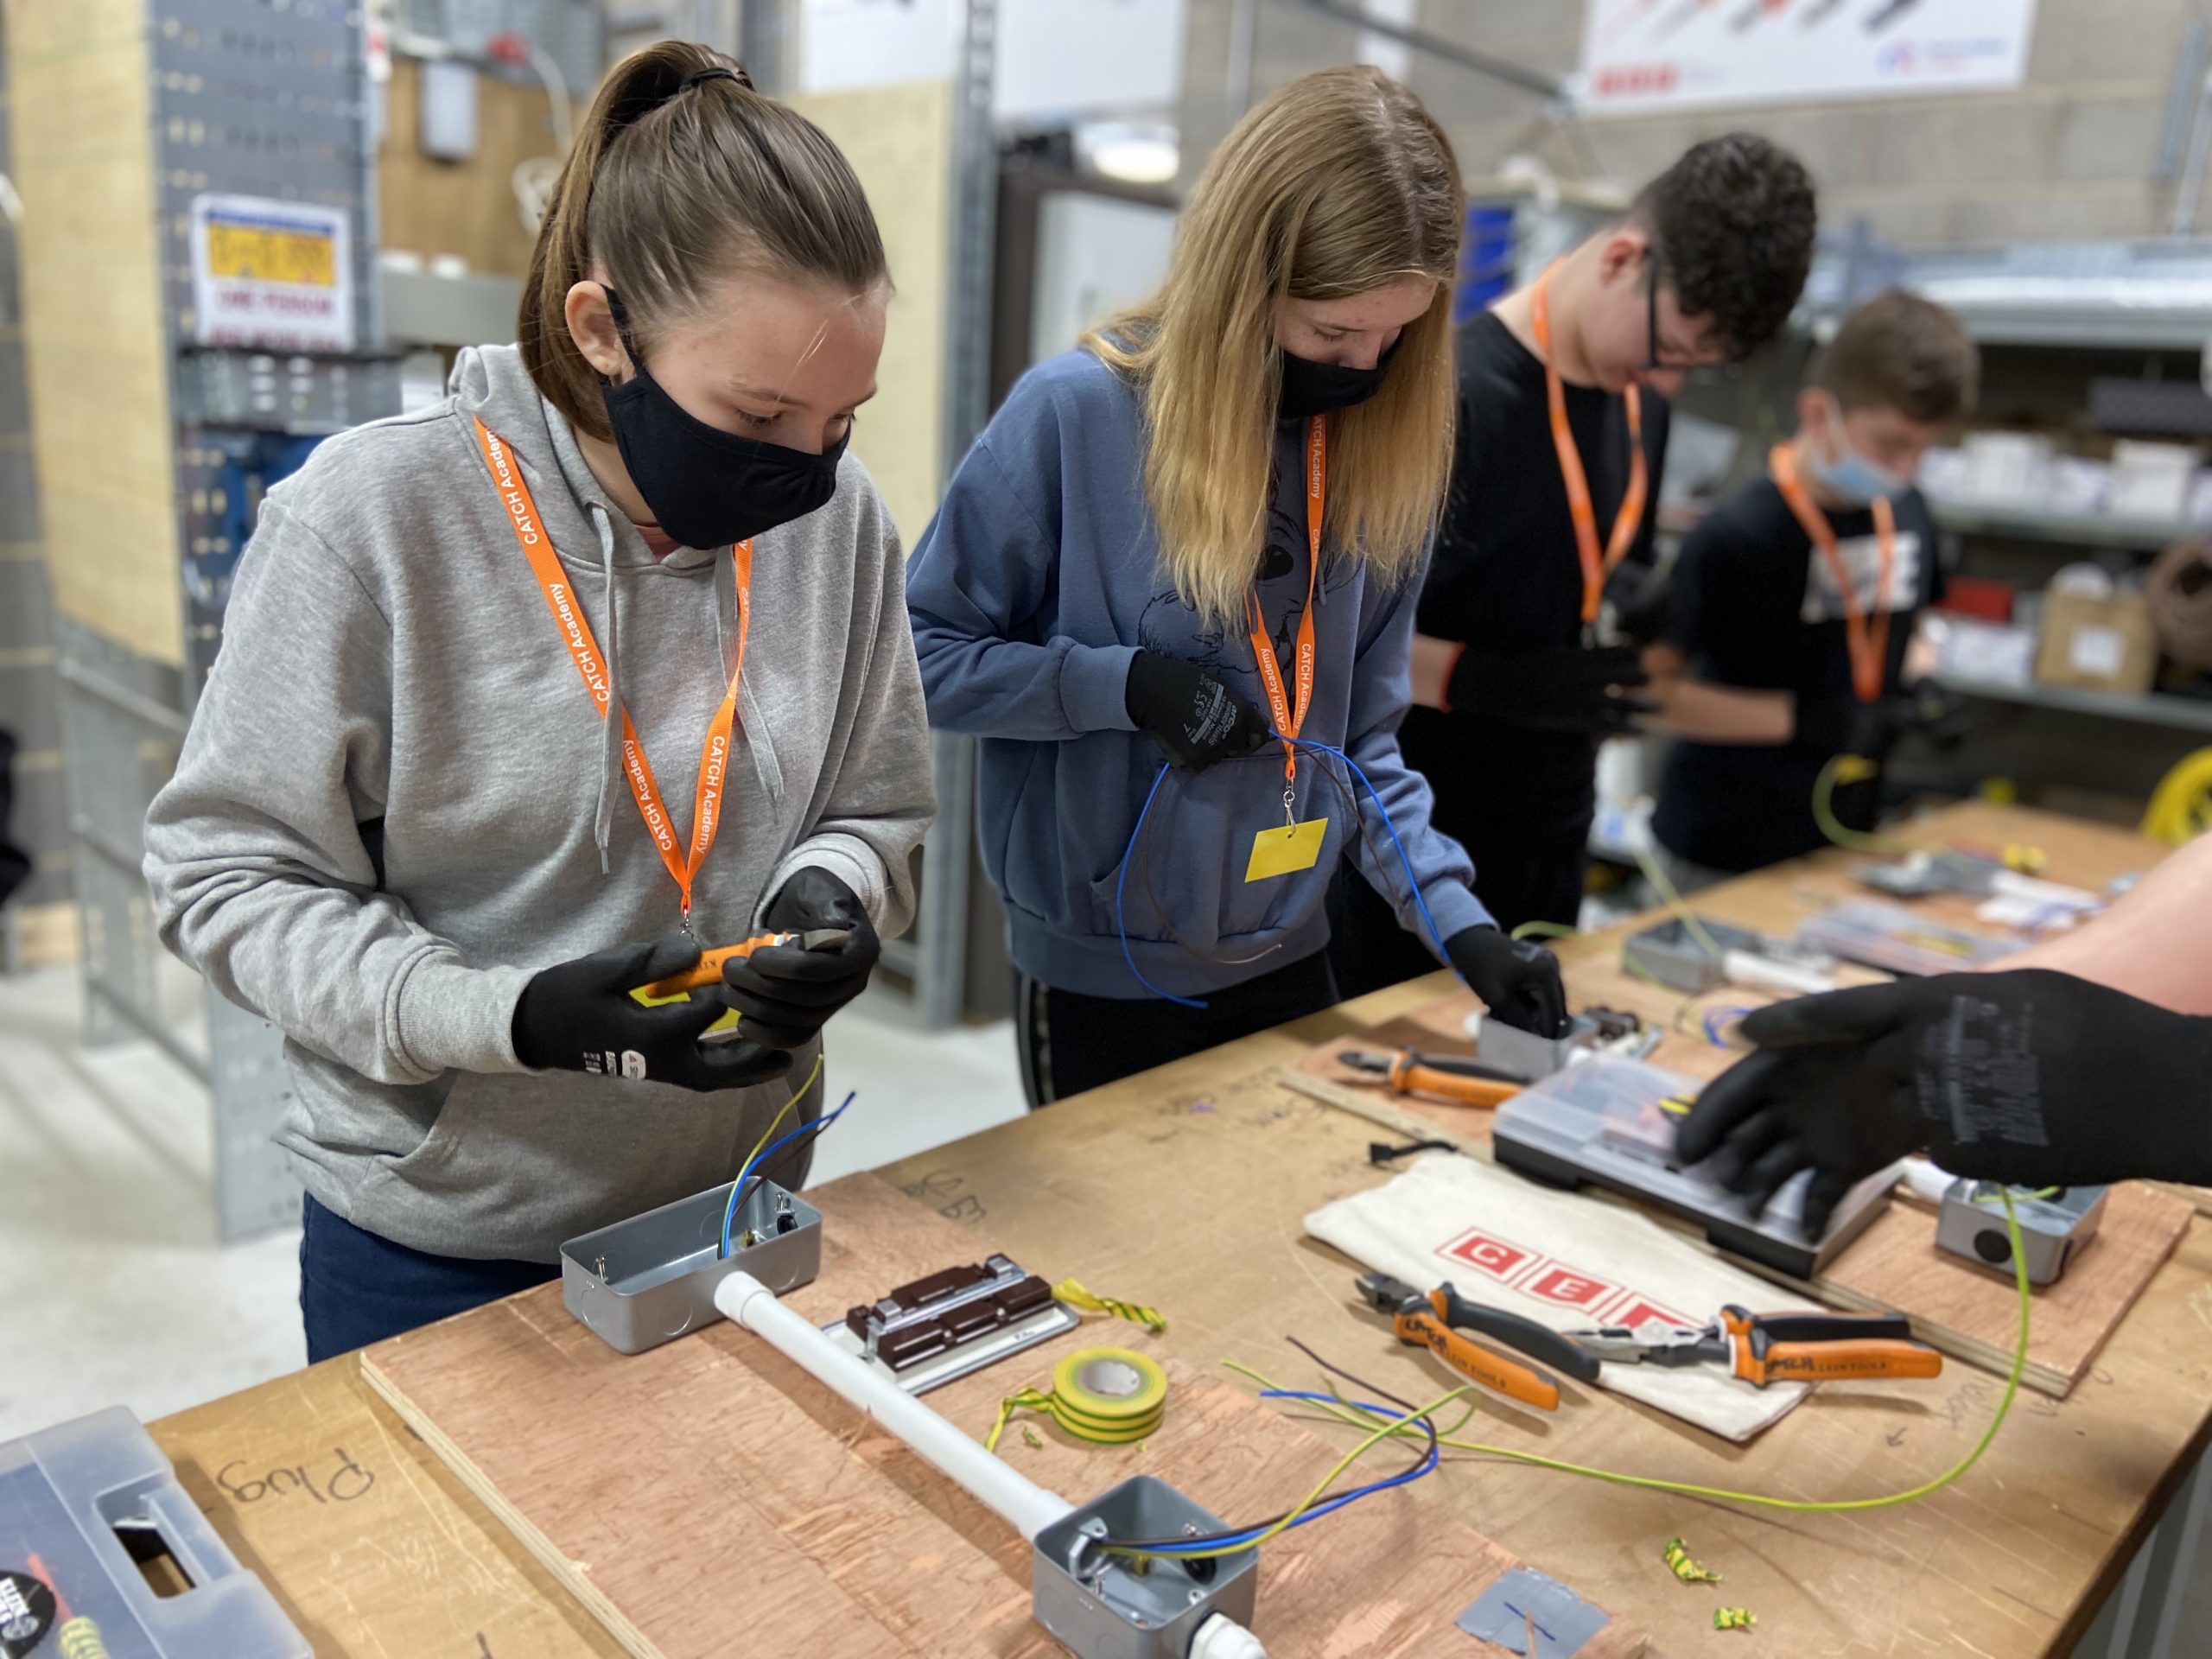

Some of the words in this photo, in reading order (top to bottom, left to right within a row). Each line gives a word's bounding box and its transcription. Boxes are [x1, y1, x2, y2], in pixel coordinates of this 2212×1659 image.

[486, 430, 516, 488] Academ
[1311, 449, 1322, 499] Academy
[505, 491, 538, 545] CATCH
[549, 583, 587, 648] Academy
[577, 651, 609, 702] CATCH
[1261, 648, 1280, 694] Academy
[1300, 643, 1312, 681] CATCH
[1273, 696, 1287, 731] CATCH
[623, 740, 652, 801] Academy
[706, 735, 725, 787] CATCH
[644, 803, 672, 851] CATCH
[696, 788, 717, 855] Academy
[215, 1447, 375, 1504] Plug
